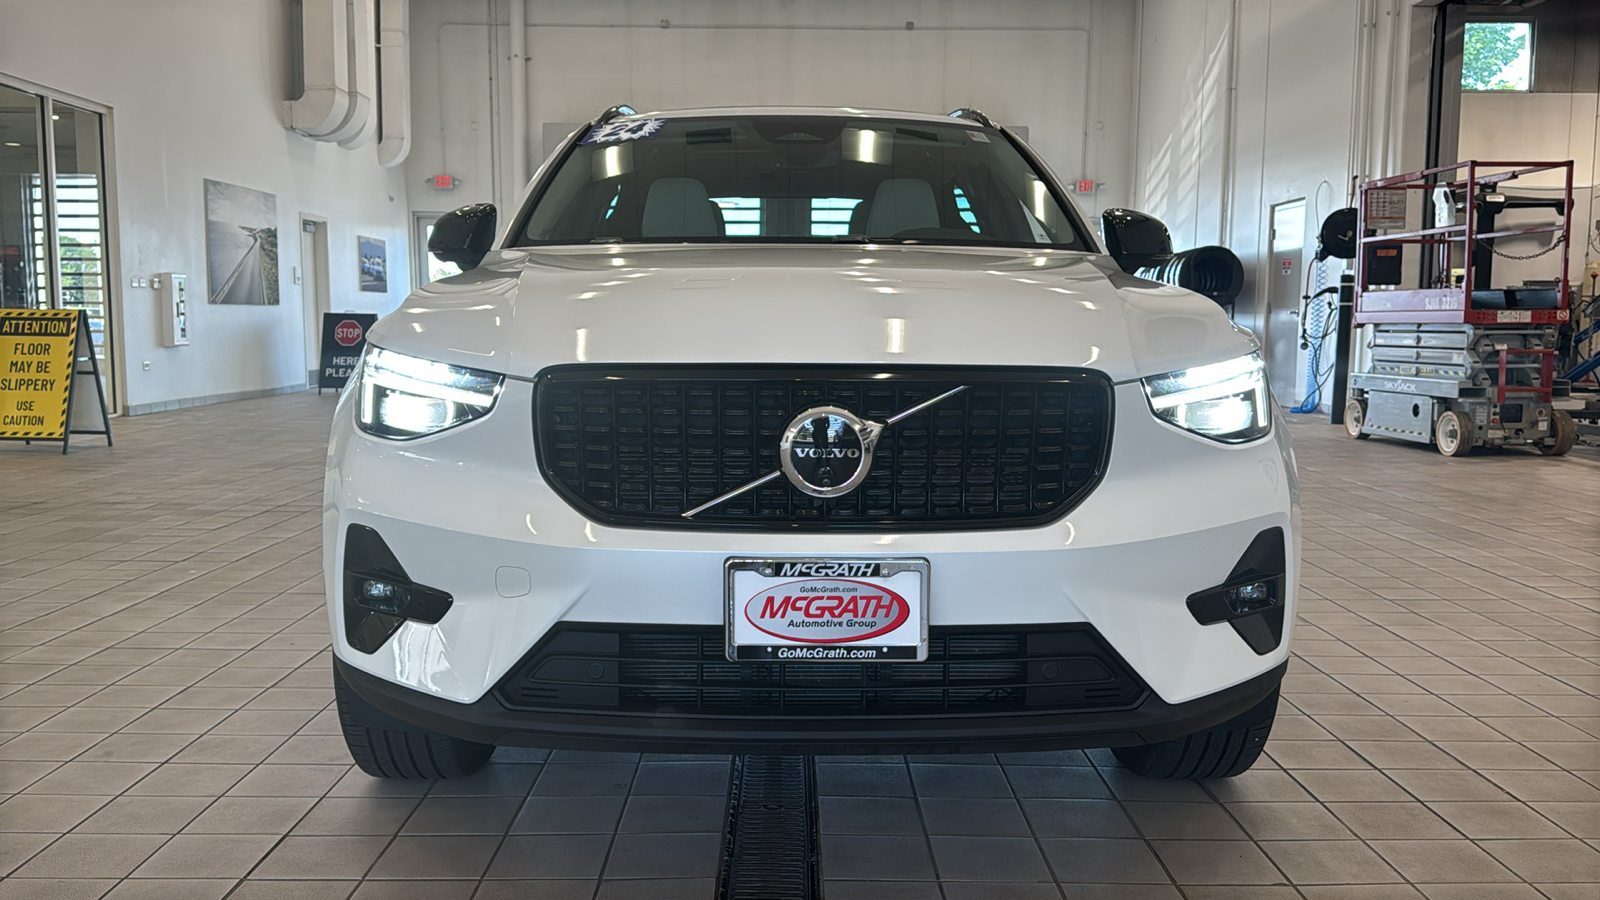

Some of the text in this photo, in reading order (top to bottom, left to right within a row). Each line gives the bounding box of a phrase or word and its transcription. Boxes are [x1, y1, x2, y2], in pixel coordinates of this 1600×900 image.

[1079, 180, 1093, 192] EXIT
[2, 320, 68, 334] ATTENTION
[337, 328, 361, 338] STOP
[13, 342, 52, 356] FLOOR
[9, 360, 51, 374] MAY BE
[325, 367, 353, 378] PLEA
[0, 378, 56, 392] SLIPPERY
[16, 400, 35, 412] USE
[2, 415, 45, 427] CAUTION
[793, 448, 860, 458] VOLVO
[799, 586, 858, 594] GoMcGrath.com
[787, 619, 877, 630] Automotive Group
[777, 647, 877, 660] GoMcGrath.com
